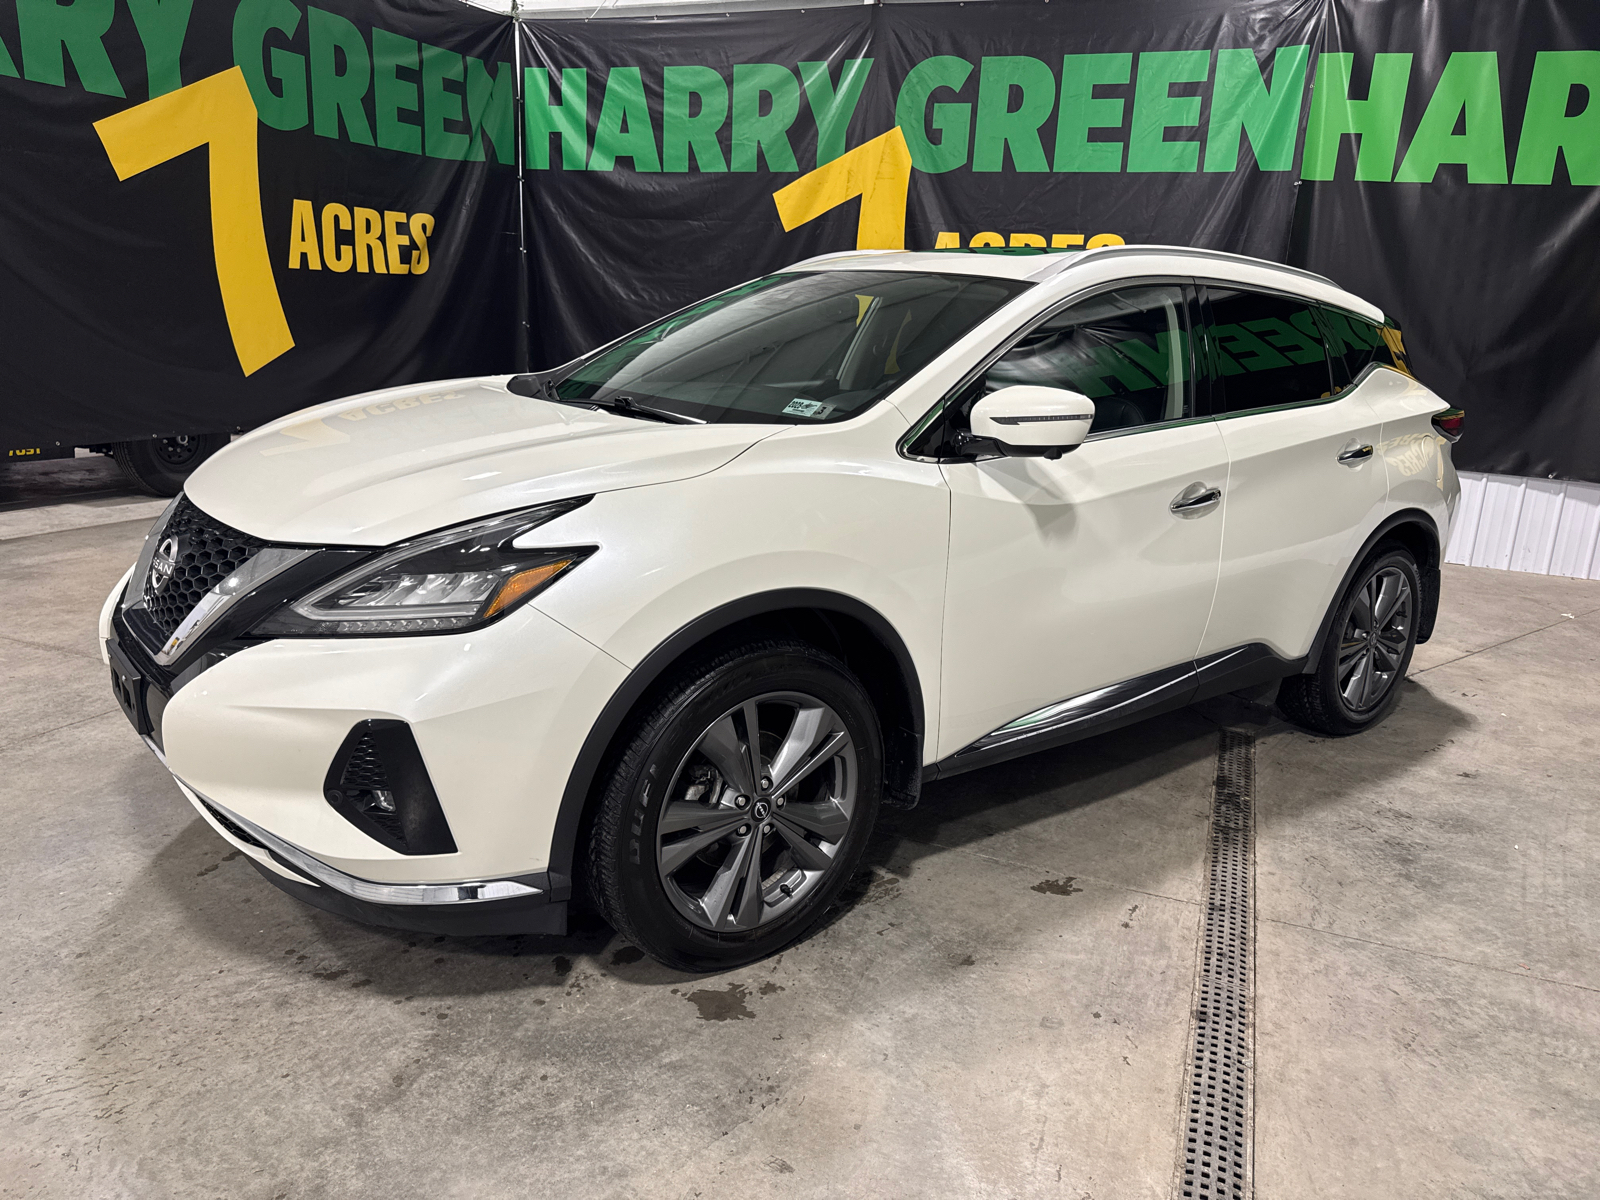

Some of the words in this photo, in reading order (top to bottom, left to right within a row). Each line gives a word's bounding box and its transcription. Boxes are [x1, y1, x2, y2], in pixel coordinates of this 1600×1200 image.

[232, 0, 516, 166] GREEN
[524, 58, 874, 173] HARRY
[896, 45, 1310, 173] GREEN
[93, 65, 296, 377] 7
[288, 199, 435, 275] ACRES
